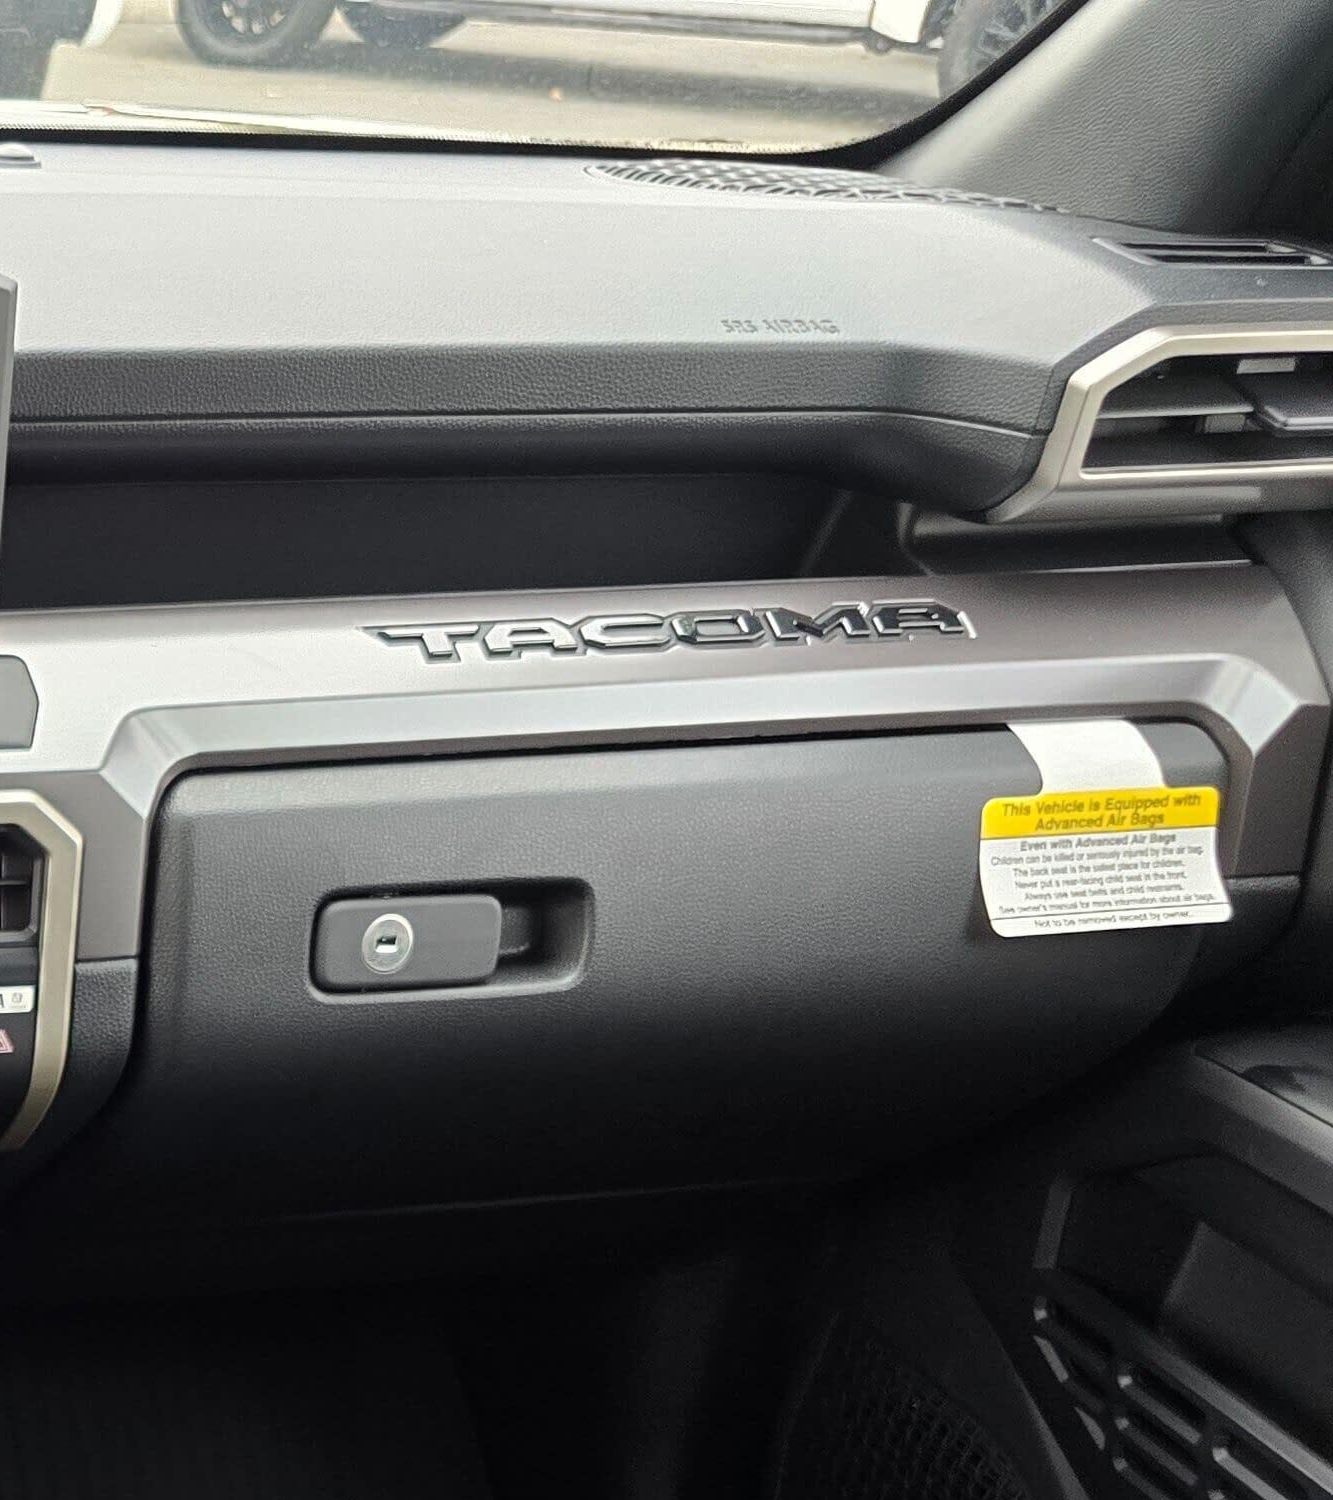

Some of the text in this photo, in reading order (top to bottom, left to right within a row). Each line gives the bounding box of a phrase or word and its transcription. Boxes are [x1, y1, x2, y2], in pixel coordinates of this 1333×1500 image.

[359, 601, 978, 664] TACOMA
[1002, 793, 1201, 817] This Vehicle is Equipped with
[1035, 812, 1164, 831] Advanced Air Bags
[1020, 841, 1047, 852] Even
[1050, 838, 1073, 848] with
[1076, 835, 1129, 848] Advanced
[1131, 834, 1147, 844] Air
